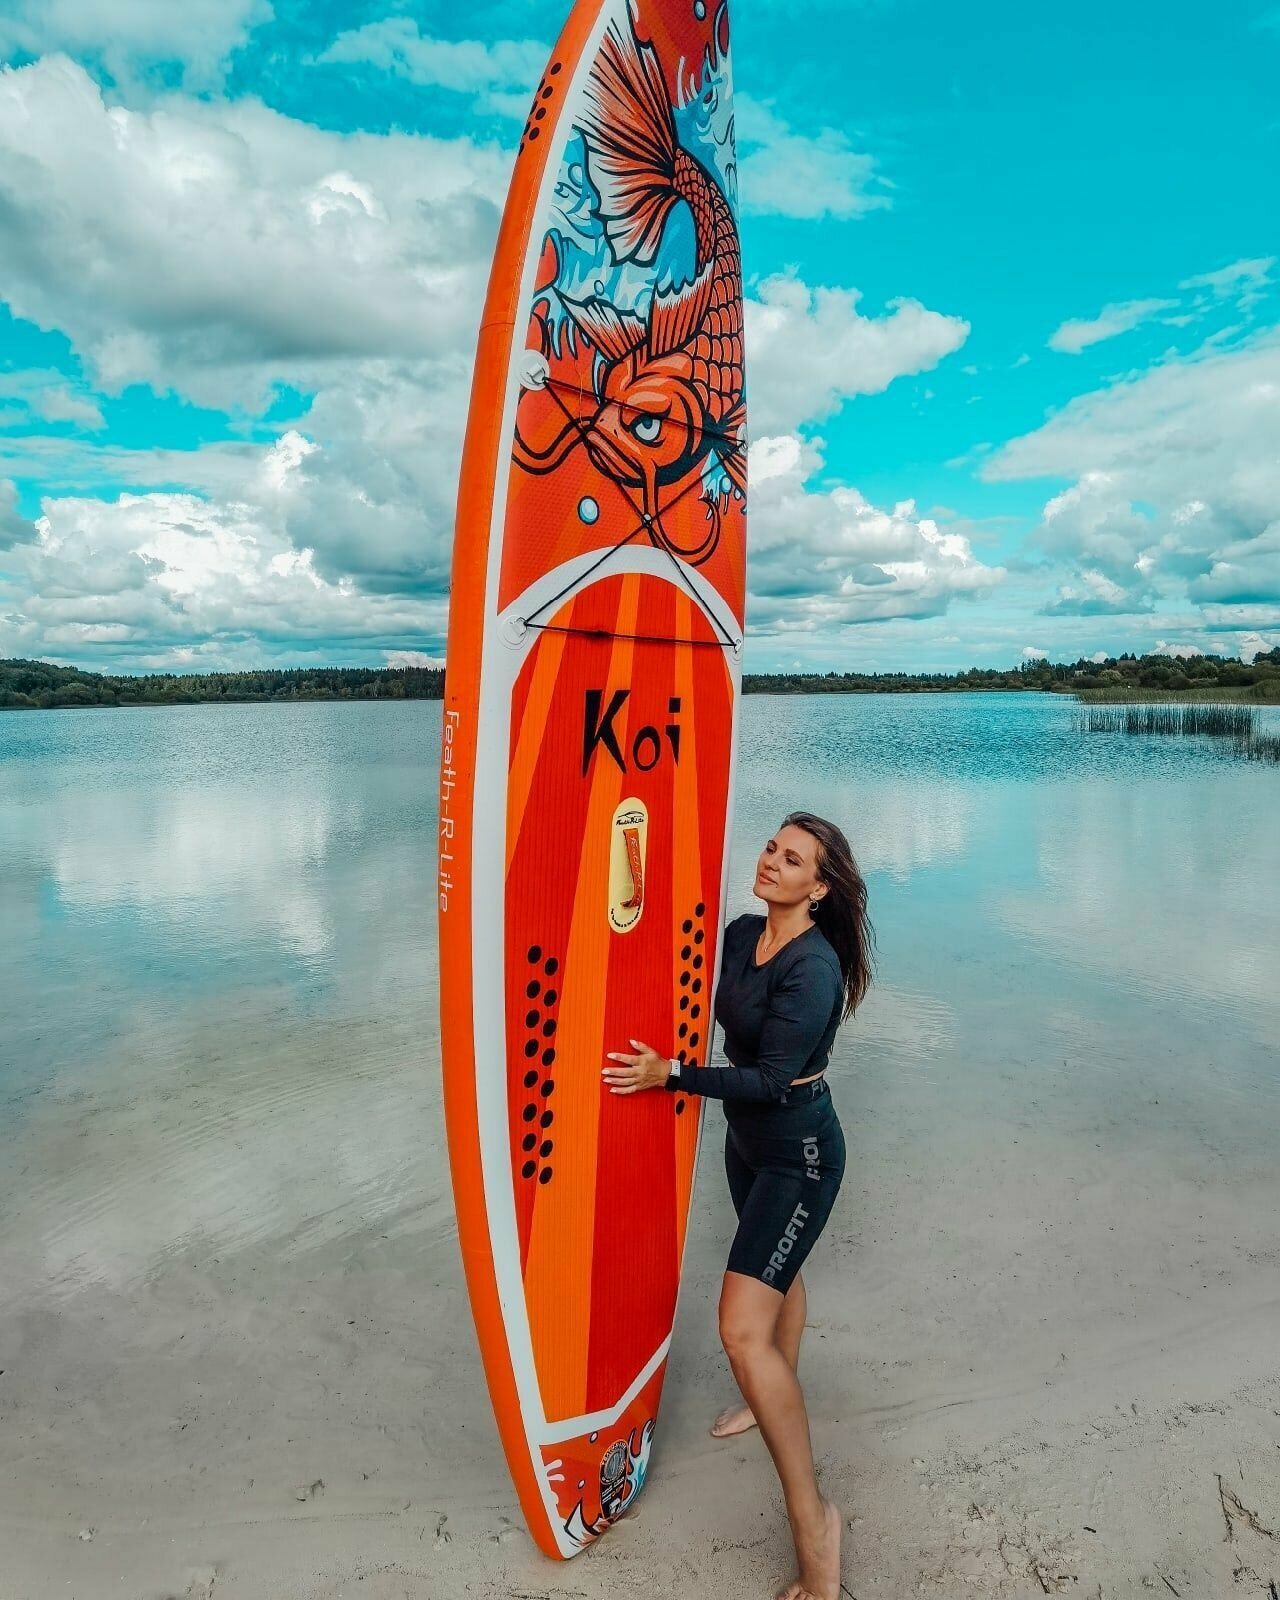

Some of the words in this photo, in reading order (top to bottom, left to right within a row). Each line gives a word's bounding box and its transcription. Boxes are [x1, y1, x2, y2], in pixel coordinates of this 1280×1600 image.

[582, 689, 682, 779] Koi
[439, 710, 460, 914] Feath-R-Lite
[762, 1202, 810, 1284] PROFIT
